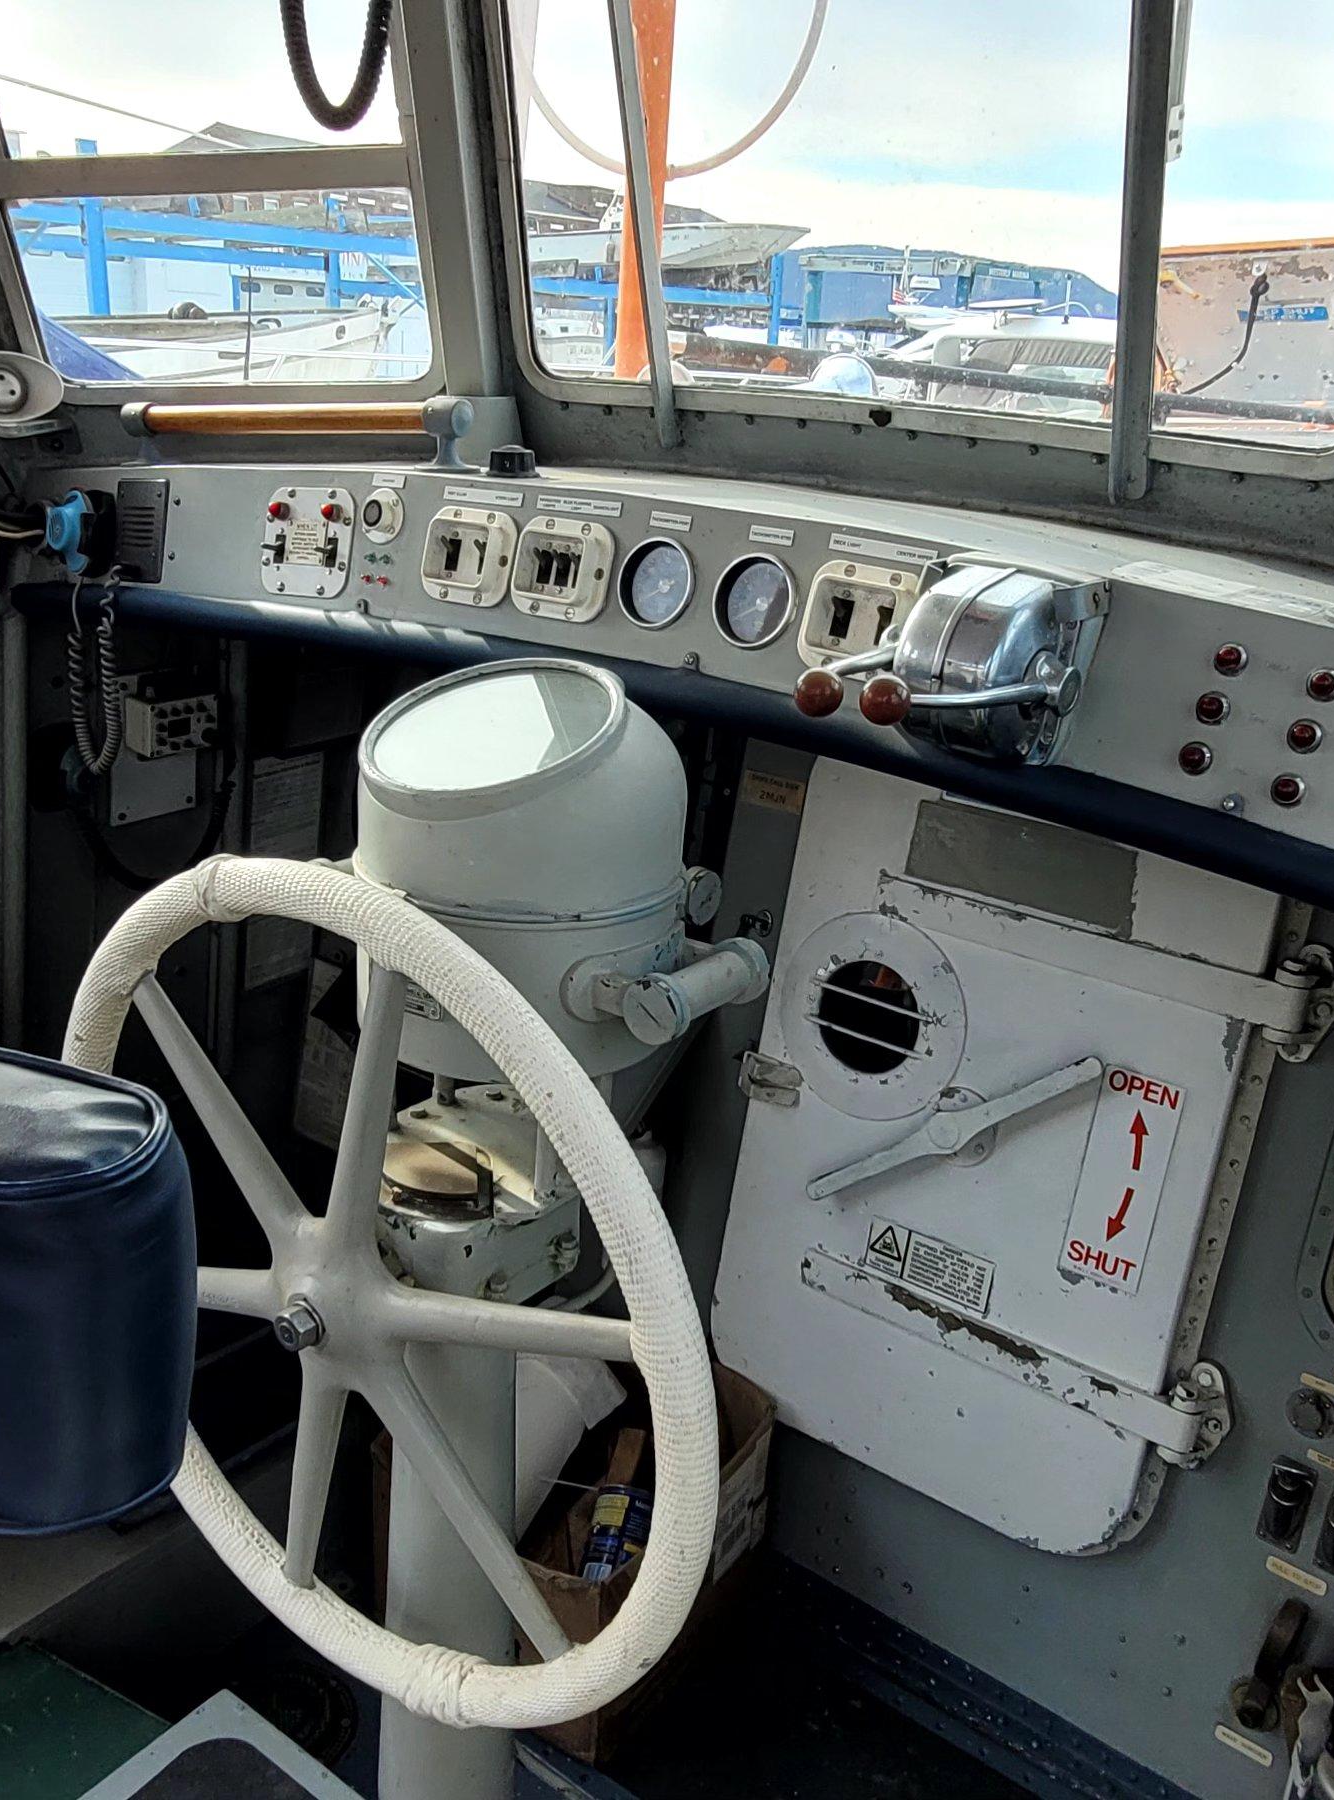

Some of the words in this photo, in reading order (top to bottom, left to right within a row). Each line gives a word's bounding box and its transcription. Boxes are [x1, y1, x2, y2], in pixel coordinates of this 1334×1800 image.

[833, 539, 846, 547] DECK
[846, 541, 862, 549] LIGHT
[1108, 1069, 1180, 1110] OPEN
[950, 1261, 968, 1270] AFTER
[1067, 1239, 1137, 1282] SHUT
